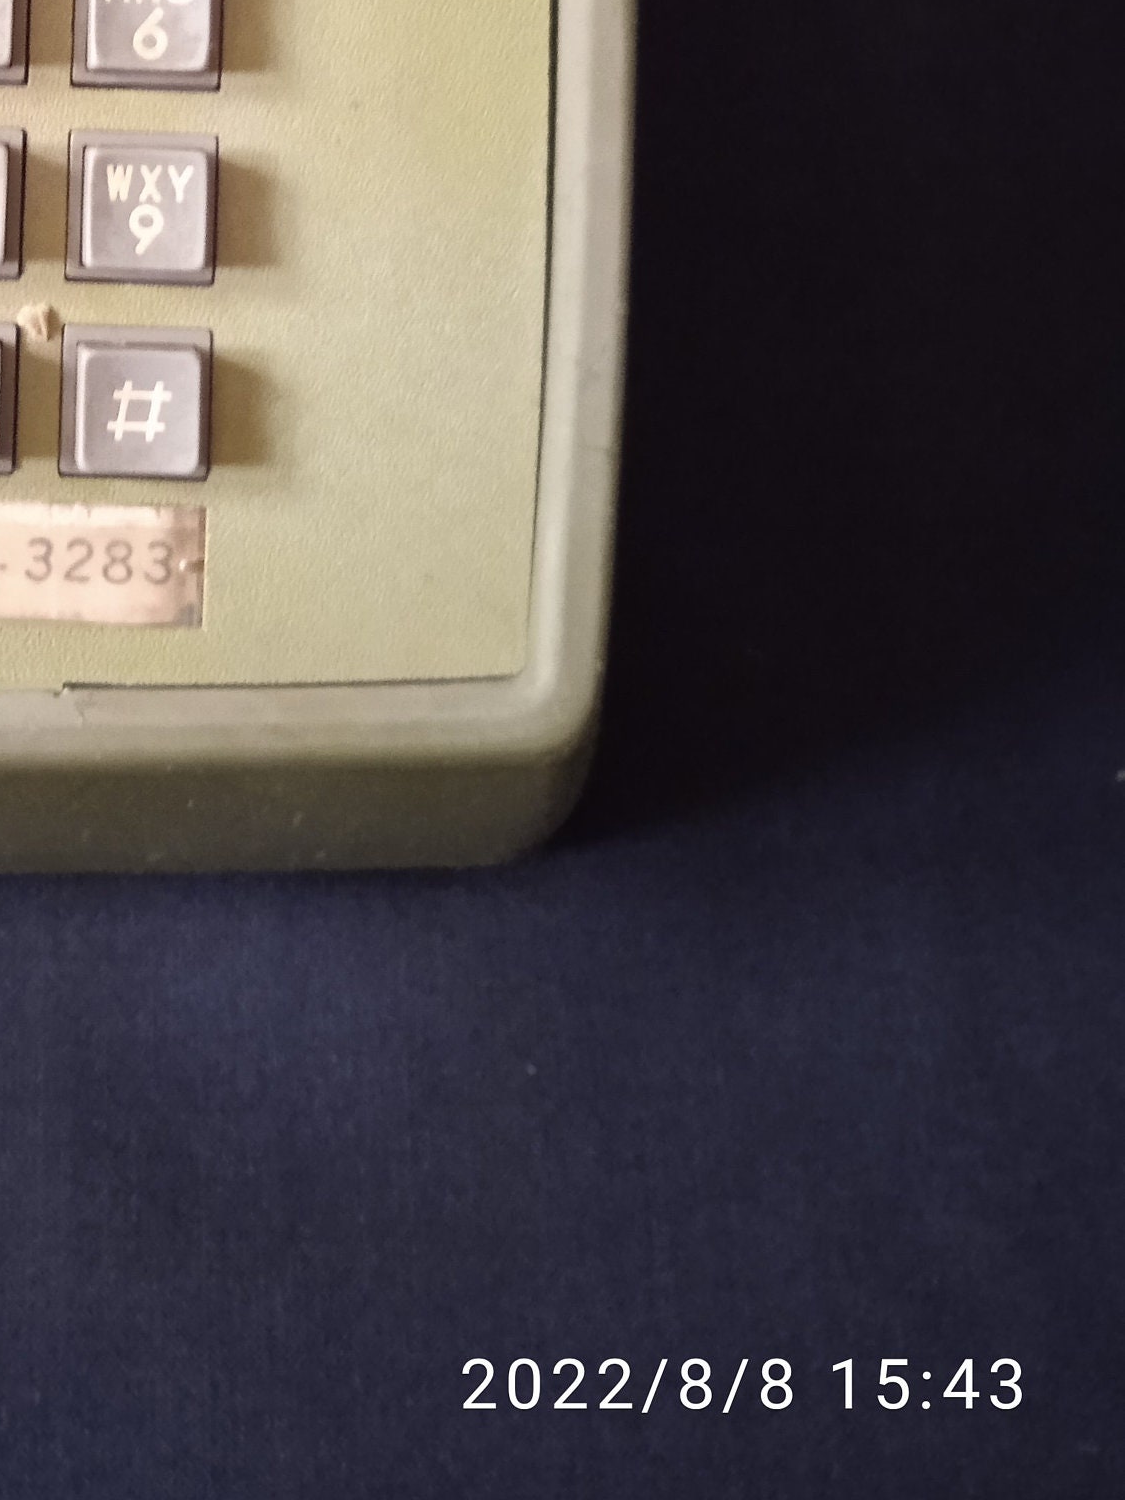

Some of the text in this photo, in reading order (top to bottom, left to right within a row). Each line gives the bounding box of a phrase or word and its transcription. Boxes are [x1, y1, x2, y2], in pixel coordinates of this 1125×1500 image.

[132, 7, 168, 61] 6
[106, 164, 194, 203] WXY
[128, 204, 164, 256] 9
